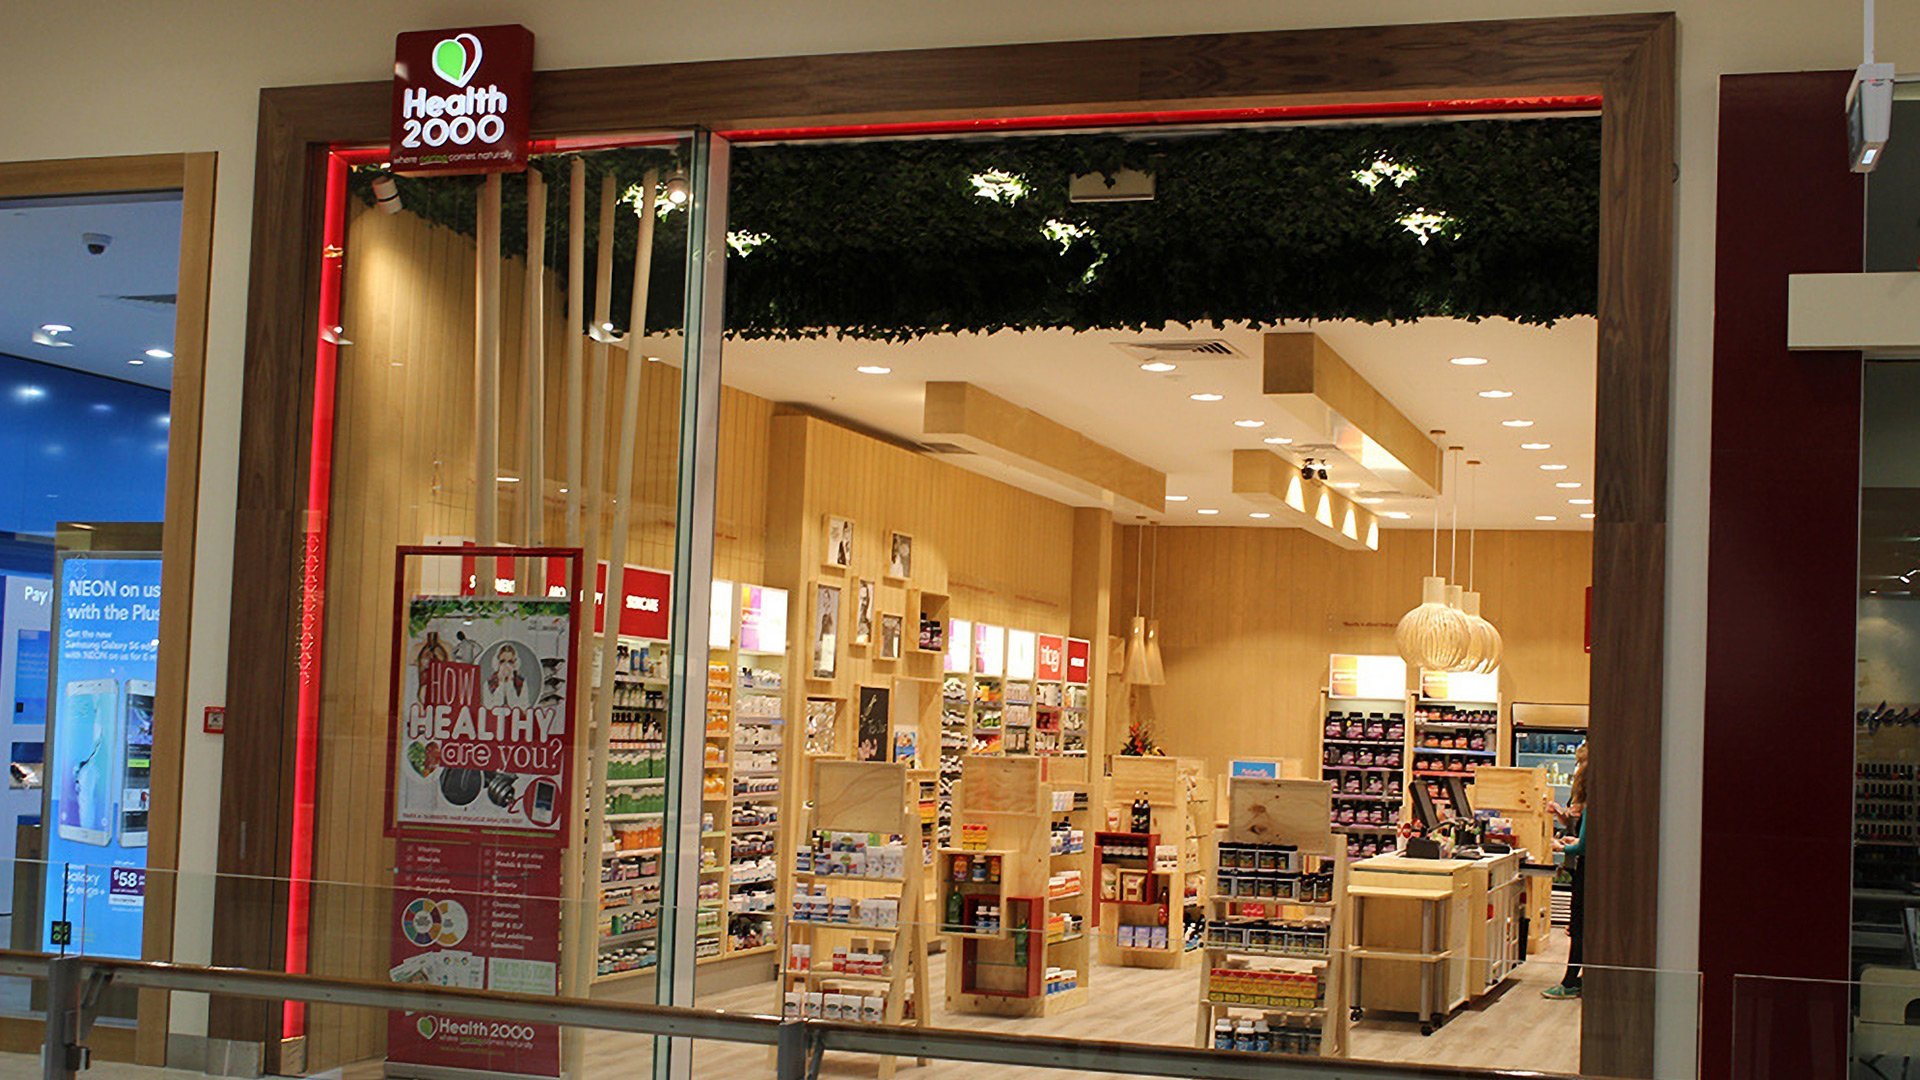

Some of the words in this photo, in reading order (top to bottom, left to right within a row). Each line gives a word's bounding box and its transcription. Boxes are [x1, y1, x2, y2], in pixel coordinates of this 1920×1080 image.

[403, 84, 508, 119] Health
[401, 114, 505, 148] 2000
[24, 585, 48, 606] Pay
[69, 579, 117, 597] NEON
[119, 584, 139, 598] on
[143, 584, 161, 598] us
[67, 603, 100, 620] with
[104, 604, 129, 620] the
[431, 662, 476, 706] HOW
[409, 704, 554, 743] HEALTHY
[441, 742, 491, 767] are
[497, 738, 563, 772] you?
[440, 1018, 488, 1036] Health
[490, 1023, 535, 1040] 2000
